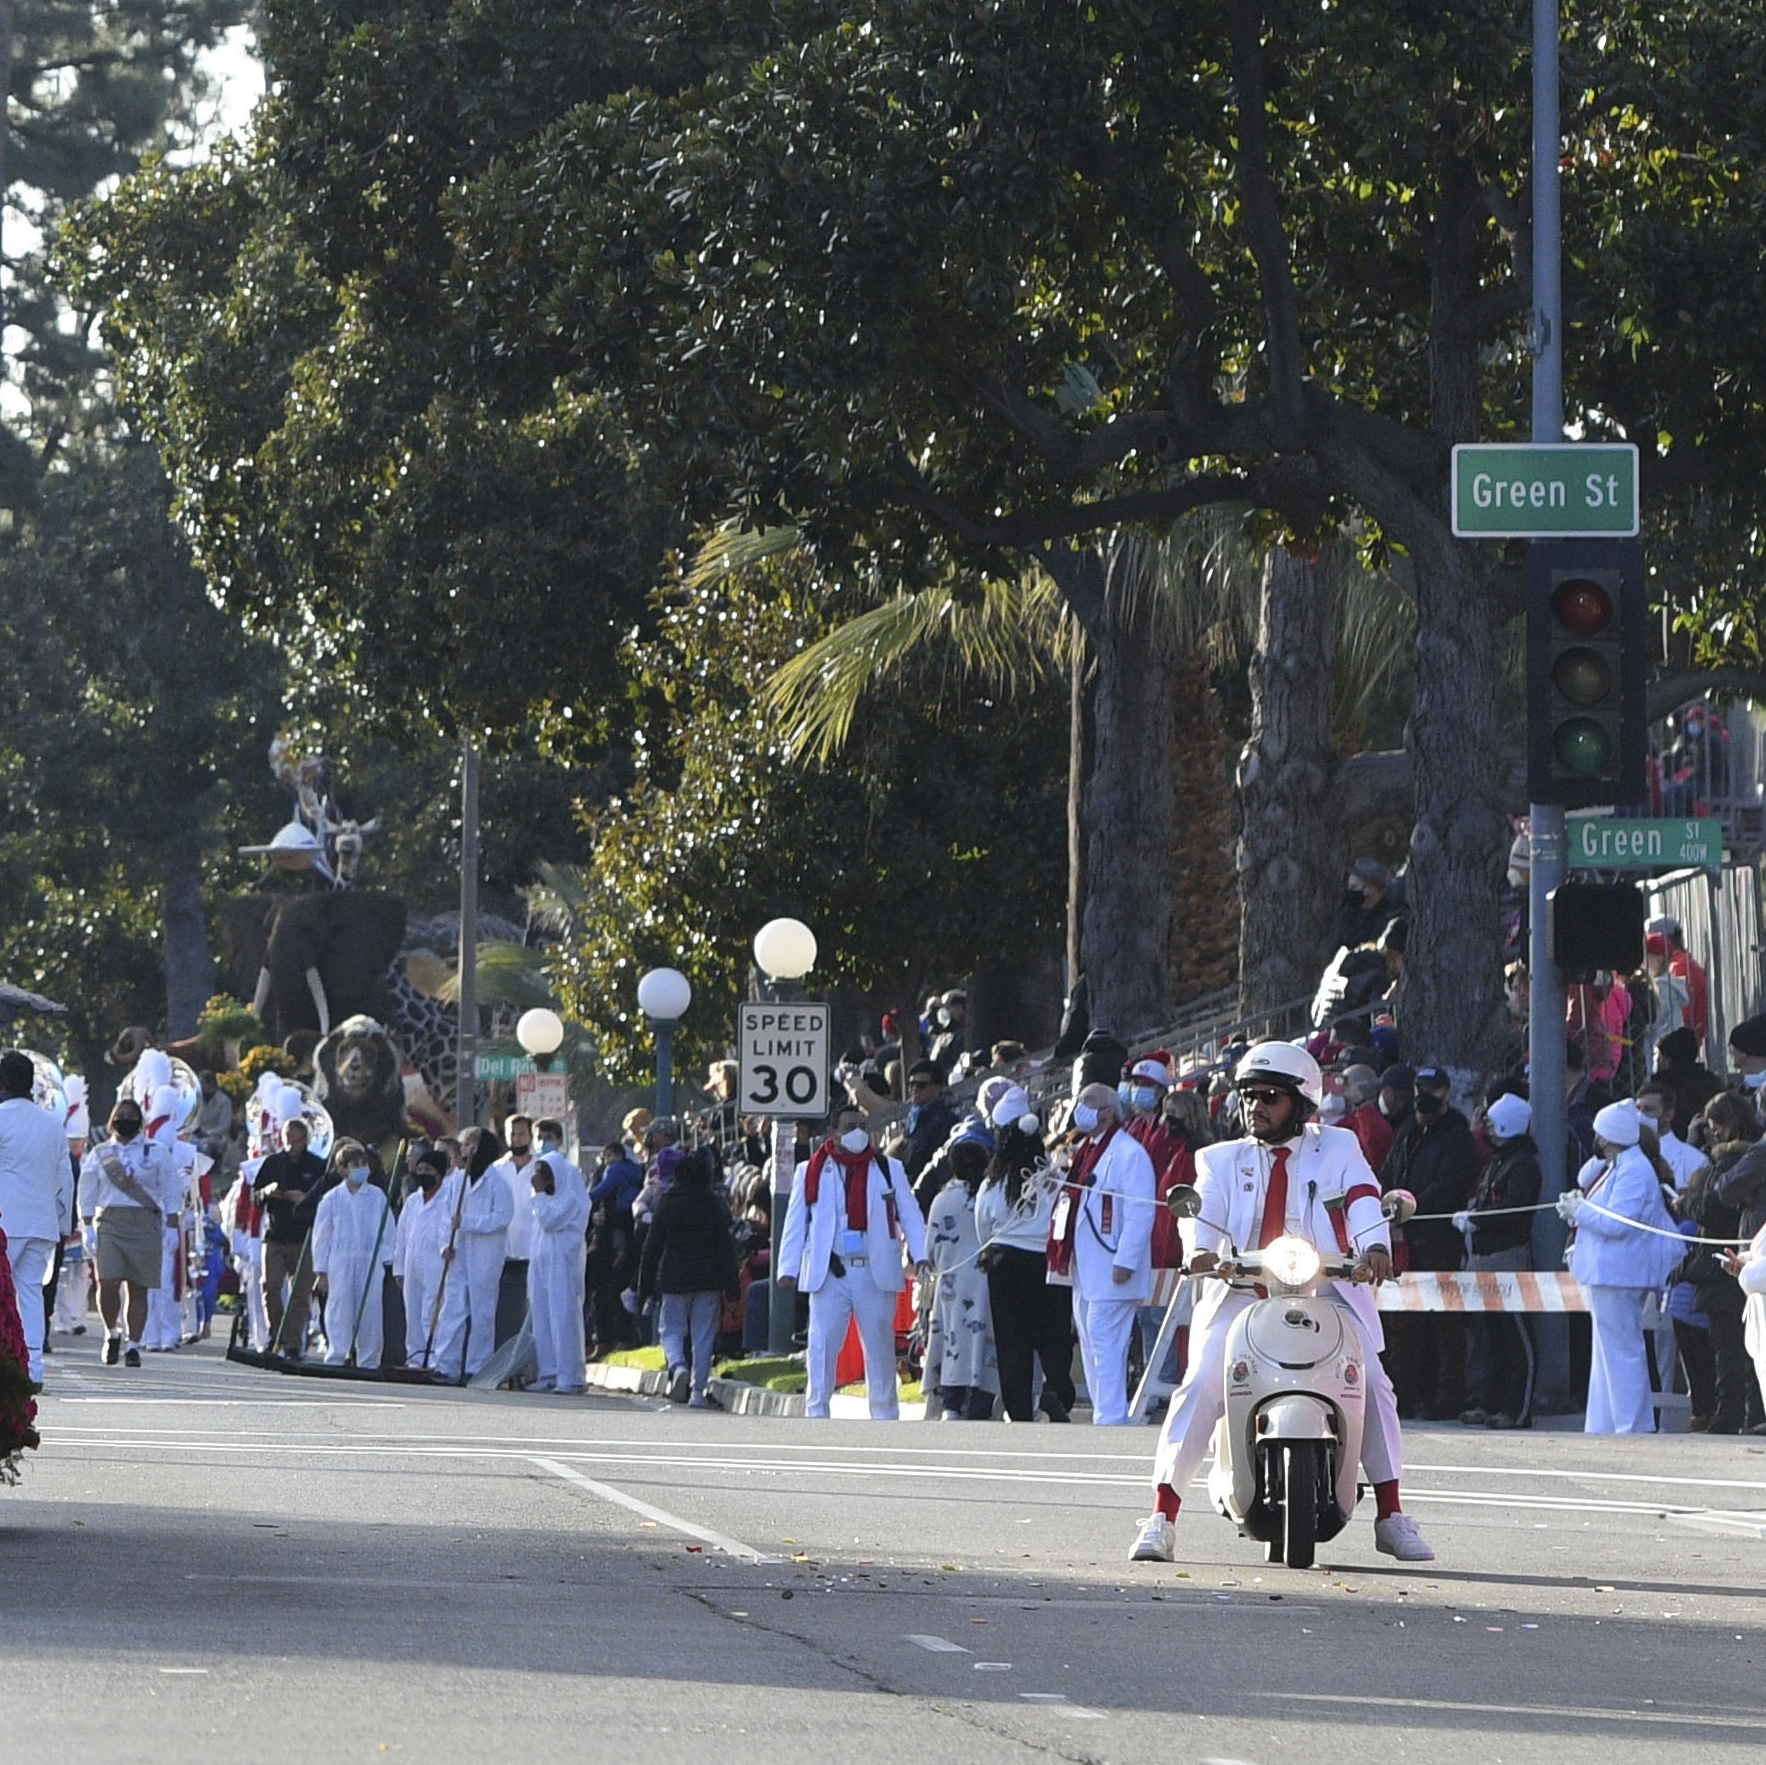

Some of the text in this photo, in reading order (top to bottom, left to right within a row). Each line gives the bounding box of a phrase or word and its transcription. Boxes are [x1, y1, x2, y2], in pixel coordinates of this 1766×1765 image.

[1473, 473, 1618, 507] Green St
[1582, 822, 1700, 856] Green ST
[1680, 844, 1707, 861] 400W
[746, 1013, 823, 1031] SPEED
[753, 1040, 816, 1057] LIMIT
[482, 1058, 504, 1074] Del
[749, 1064, 817, 1105] 30
